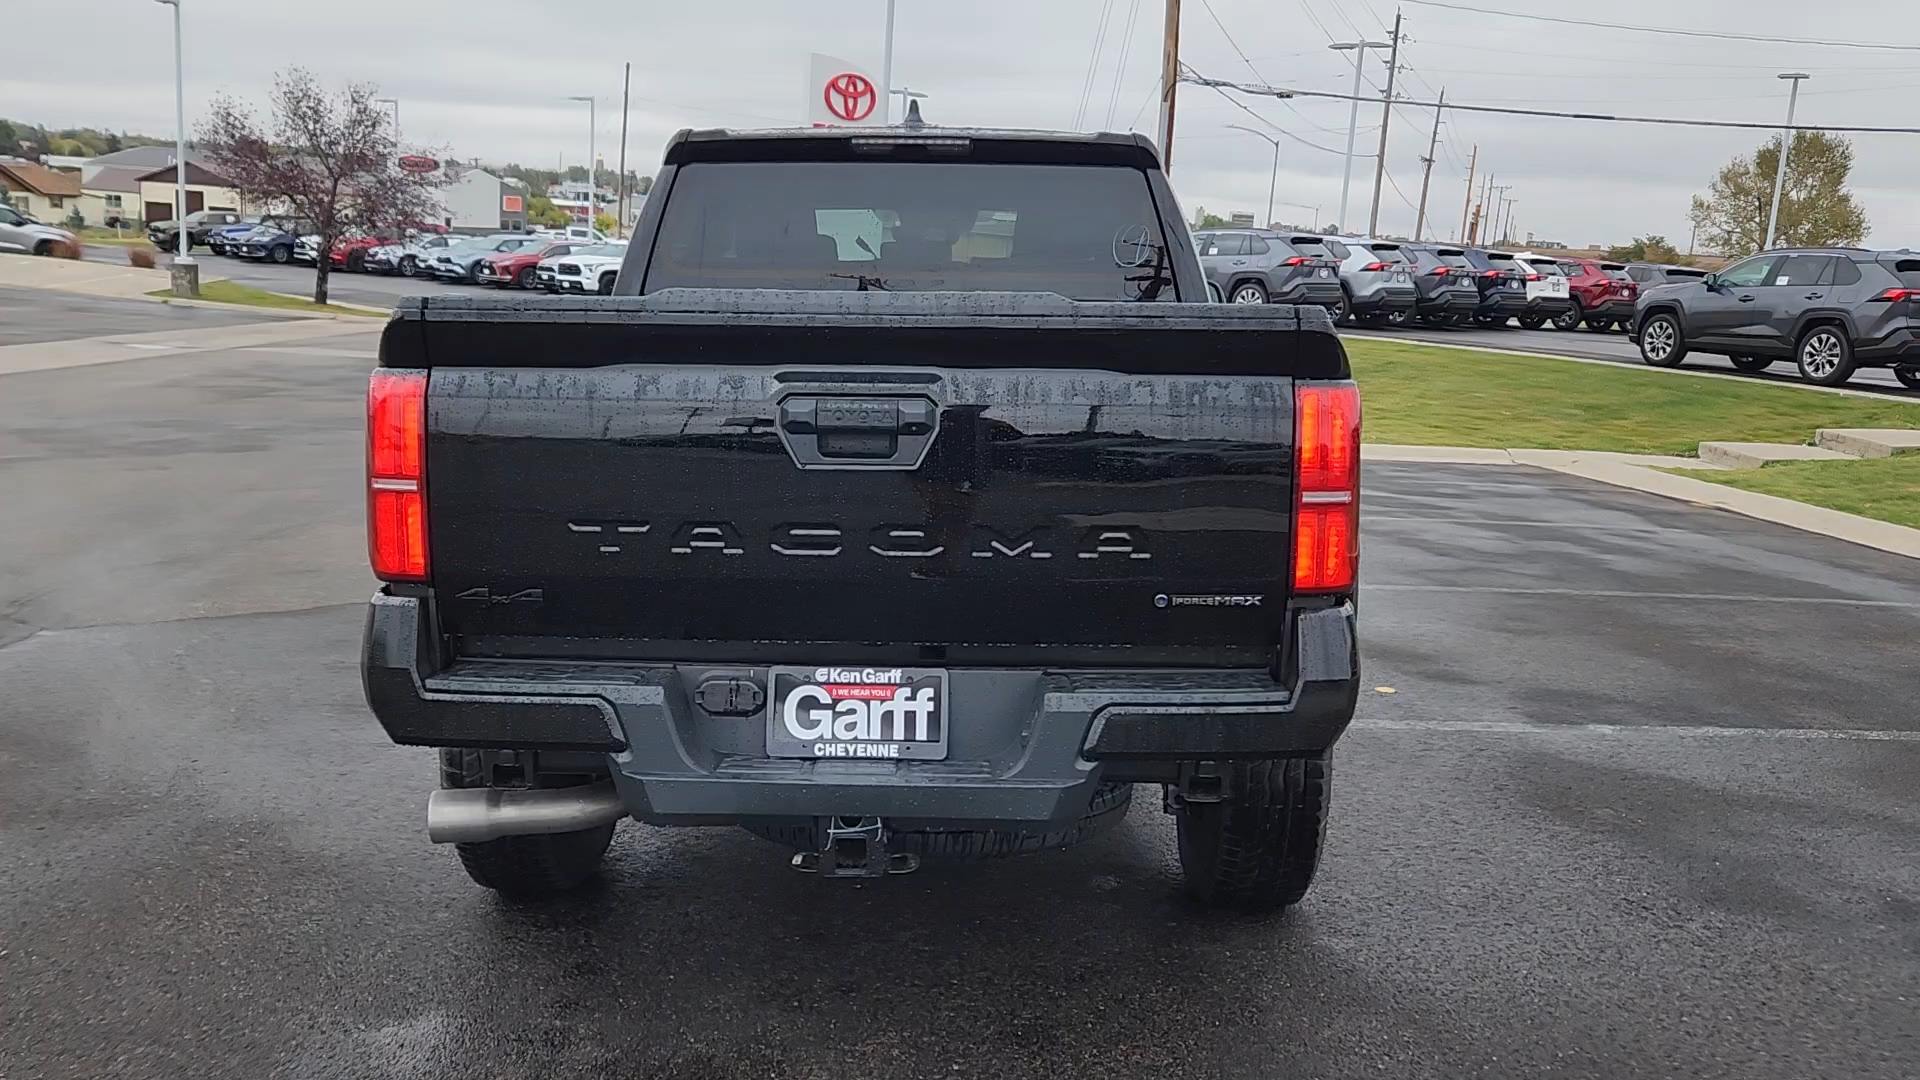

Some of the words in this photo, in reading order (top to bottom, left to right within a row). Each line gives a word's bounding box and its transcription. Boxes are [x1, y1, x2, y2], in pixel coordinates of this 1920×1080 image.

[819, 409, 894, 424] TOYOTA
[567, 520, 1152, 560] TACOMA
[829, 668, 860, 684] Ken
[861, 668, 902, 684] Garff
[837, 689, 849, 697] WE
[850, 689, 870, 697] HEAR
[871, 689, 886, 697] YOU
[783, 684, 935, 741] Garff
[814, 743, 899, 758] CHEYENNE
